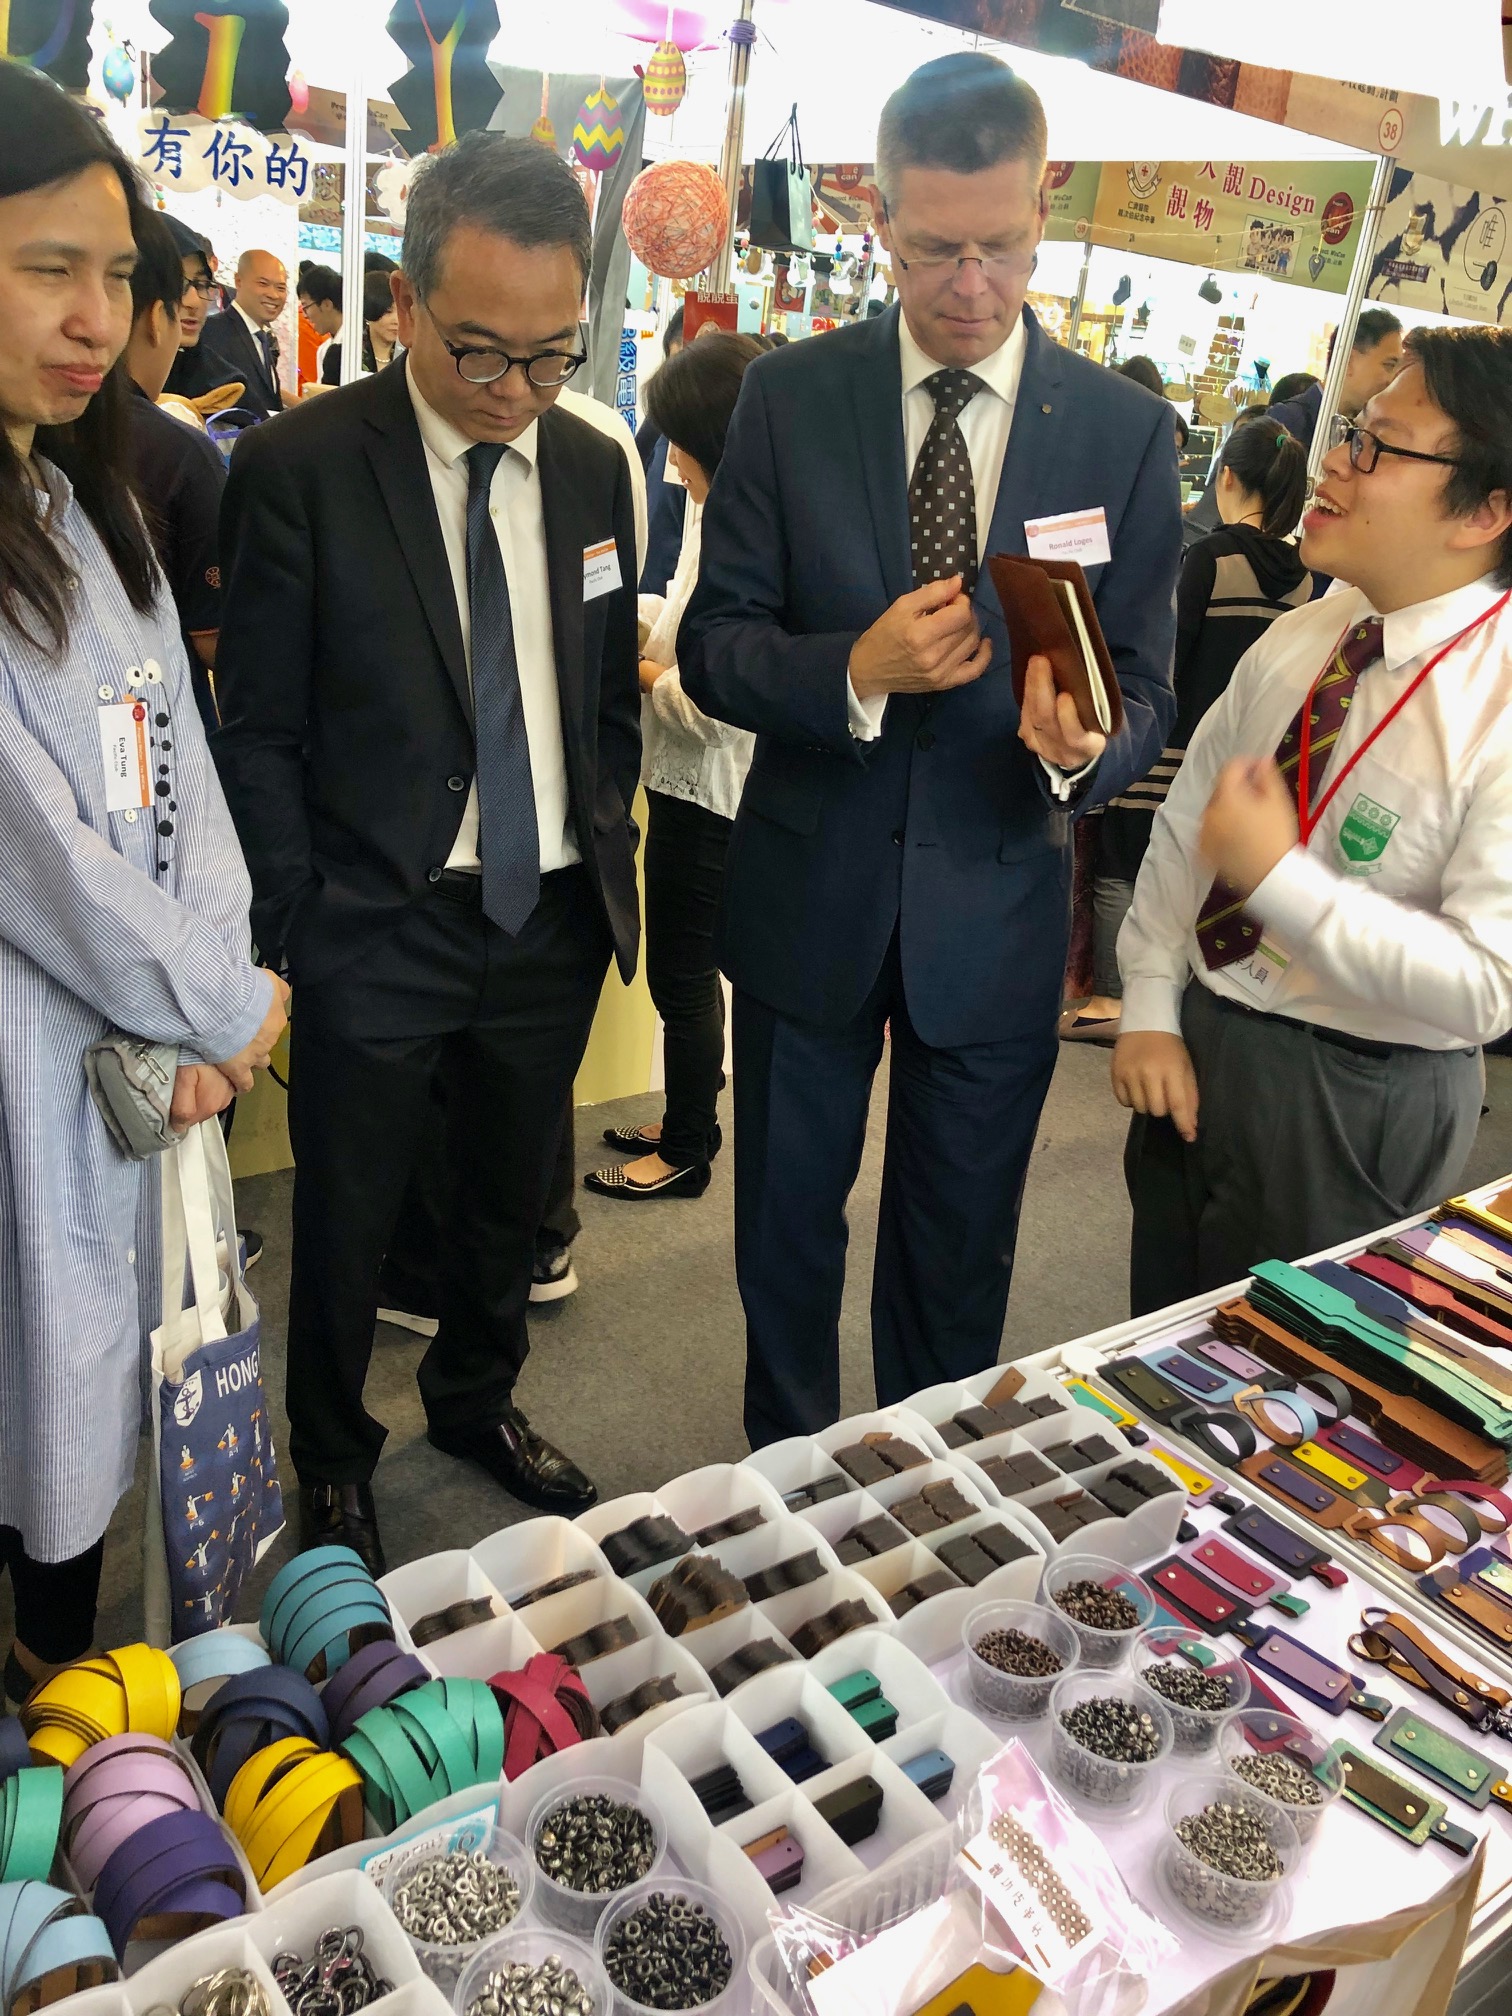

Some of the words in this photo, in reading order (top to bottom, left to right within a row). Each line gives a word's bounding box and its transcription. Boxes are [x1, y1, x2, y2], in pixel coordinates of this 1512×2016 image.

[1383, 121, 1398, 140] 38
[142, 116, 309, 197] 有你的
[1166, 185, 1215, 232] 靚物
[1248, 176, 1316, 217] Design
[1048, 540, 1073, 550] Ronald
[118, 736, 126, 753] Eva
[119, 754, 128, 778] Tung
[215, 1350, 259, 1398] HONG
